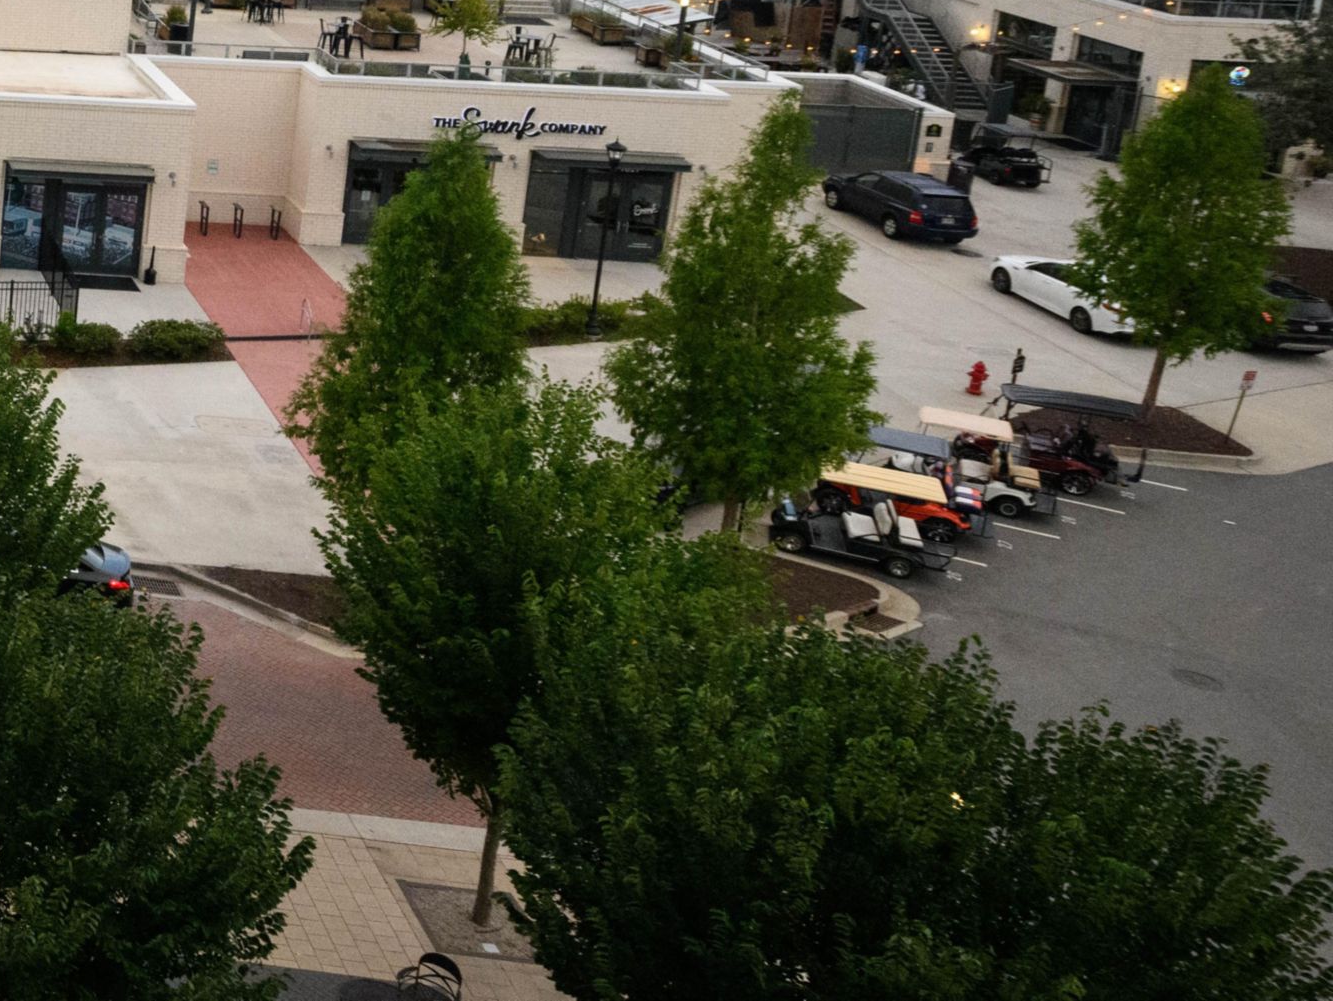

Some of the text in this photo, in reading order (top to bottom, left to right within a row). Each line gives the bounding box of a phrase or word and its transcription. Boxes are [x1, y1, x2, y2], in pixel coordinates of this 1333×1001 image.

[434, 107, 607, 140] THE Swank COMPANY
